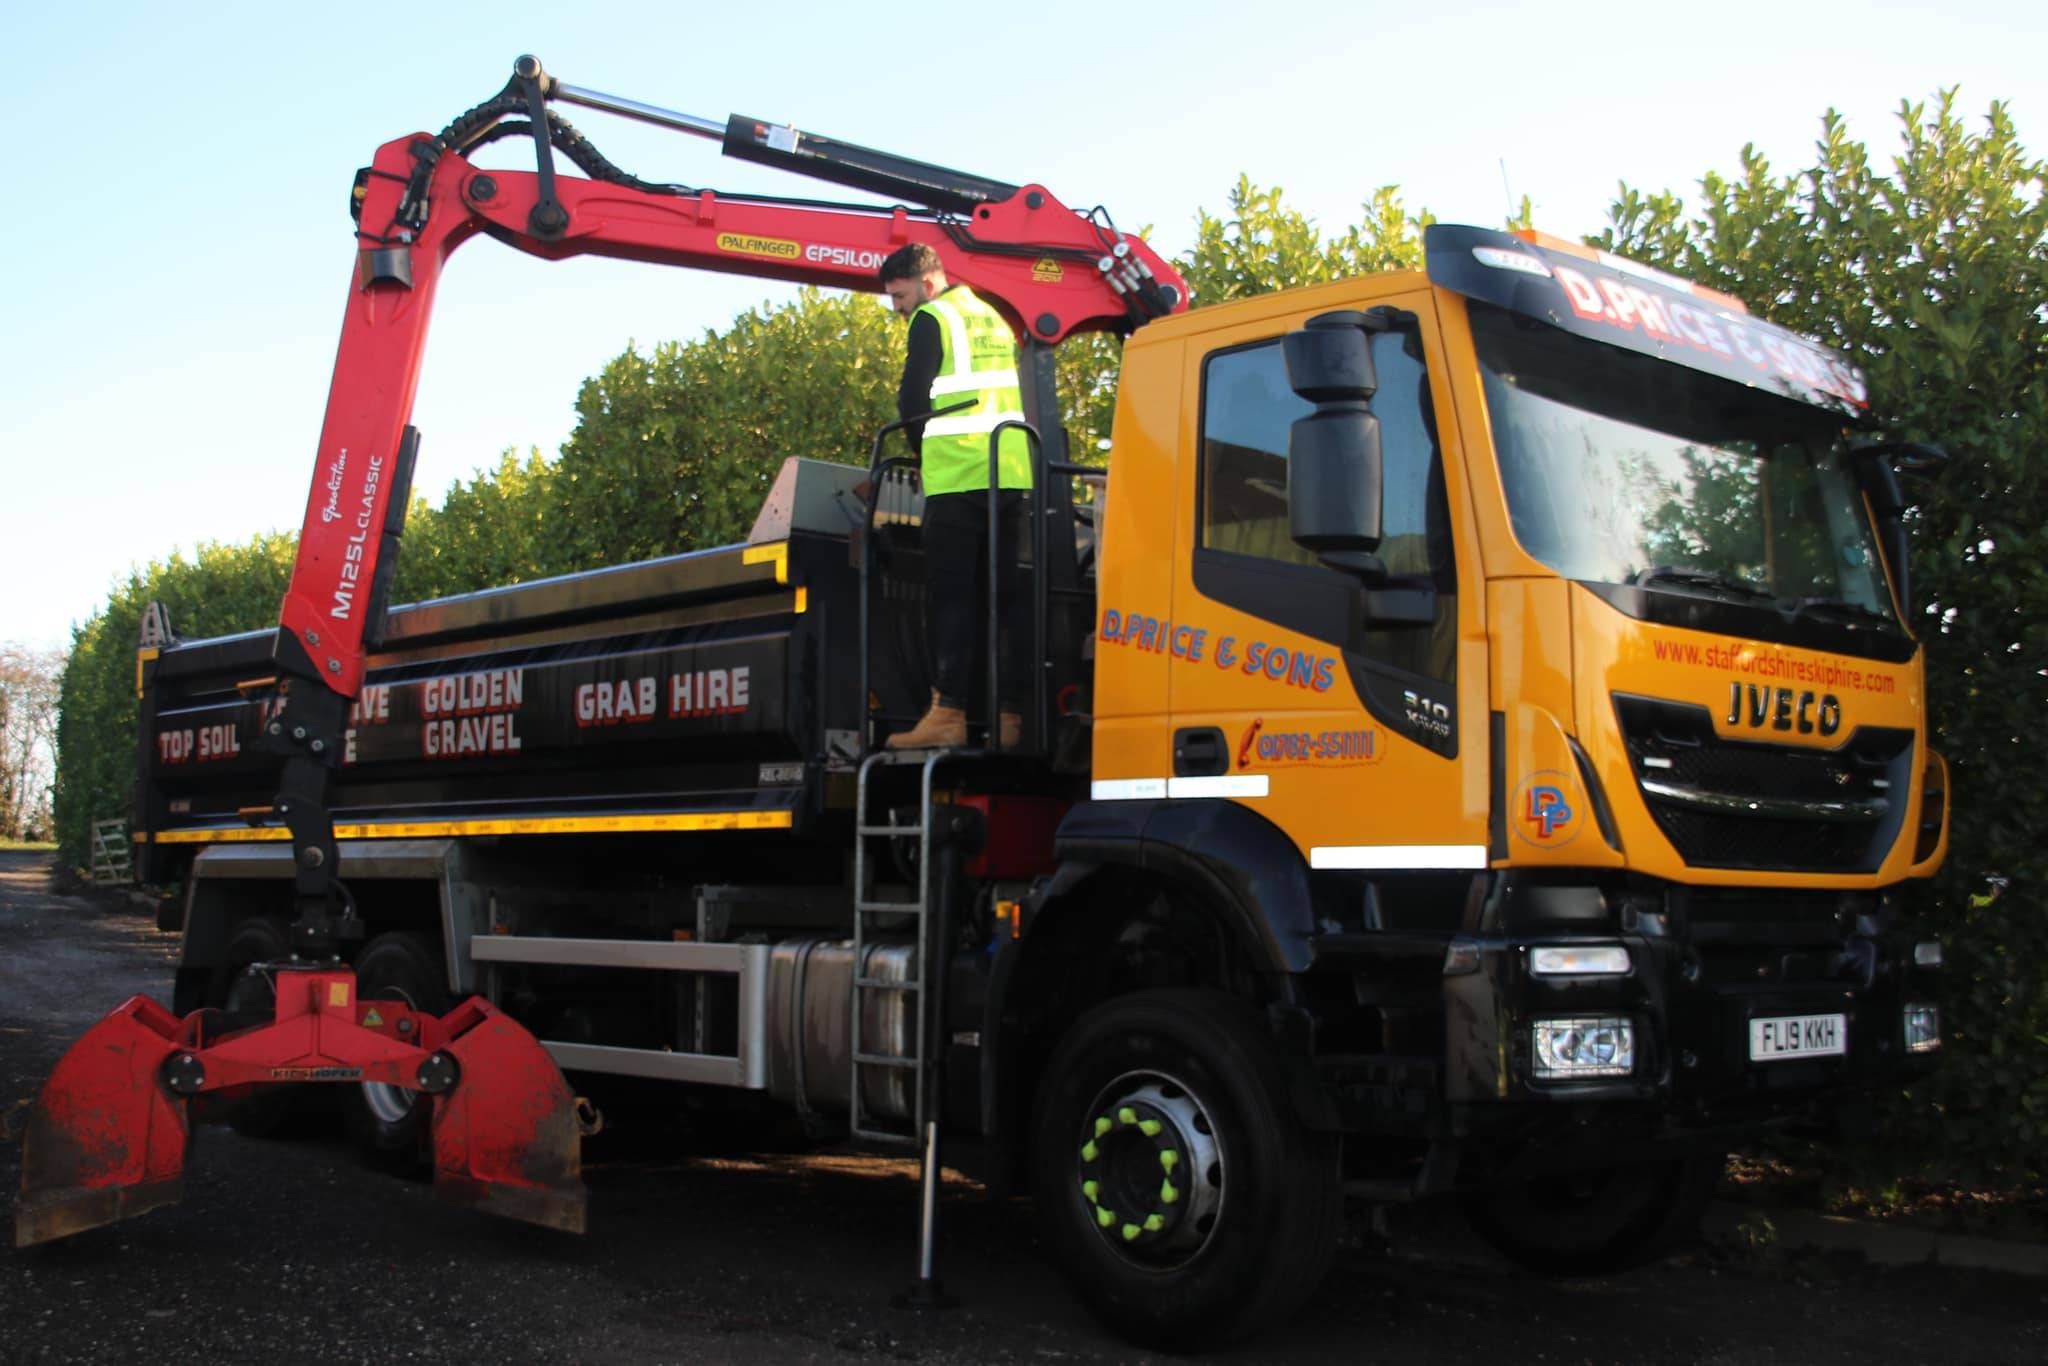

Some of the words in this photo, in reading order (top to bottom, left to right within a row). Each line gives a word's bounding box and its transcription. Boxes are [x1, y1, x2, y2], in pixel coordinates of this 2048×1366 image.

[721, 235, 796, 256] PALFINGER
[357, 454, 383, 529] CLASSIC
[1100, 609, 1208, 662] D.PRICE
[1242, 641, 1337, 693] SONS
[423, 668, 523, 718] GOLDEN
[576, 677, 656, 726] GRAB
[670, 666, 750, 717] HIRE
[1727, 680, 1841, 737] IVECO
[158, 729, 194, 764] TOP
[198, 724, 241, 760] SOIL
[422, 712, 521, 759] GRAVEL
[1762, 1020, 1799, 1052] FL19
[1804, 1018, 1835, 1048] KKH
